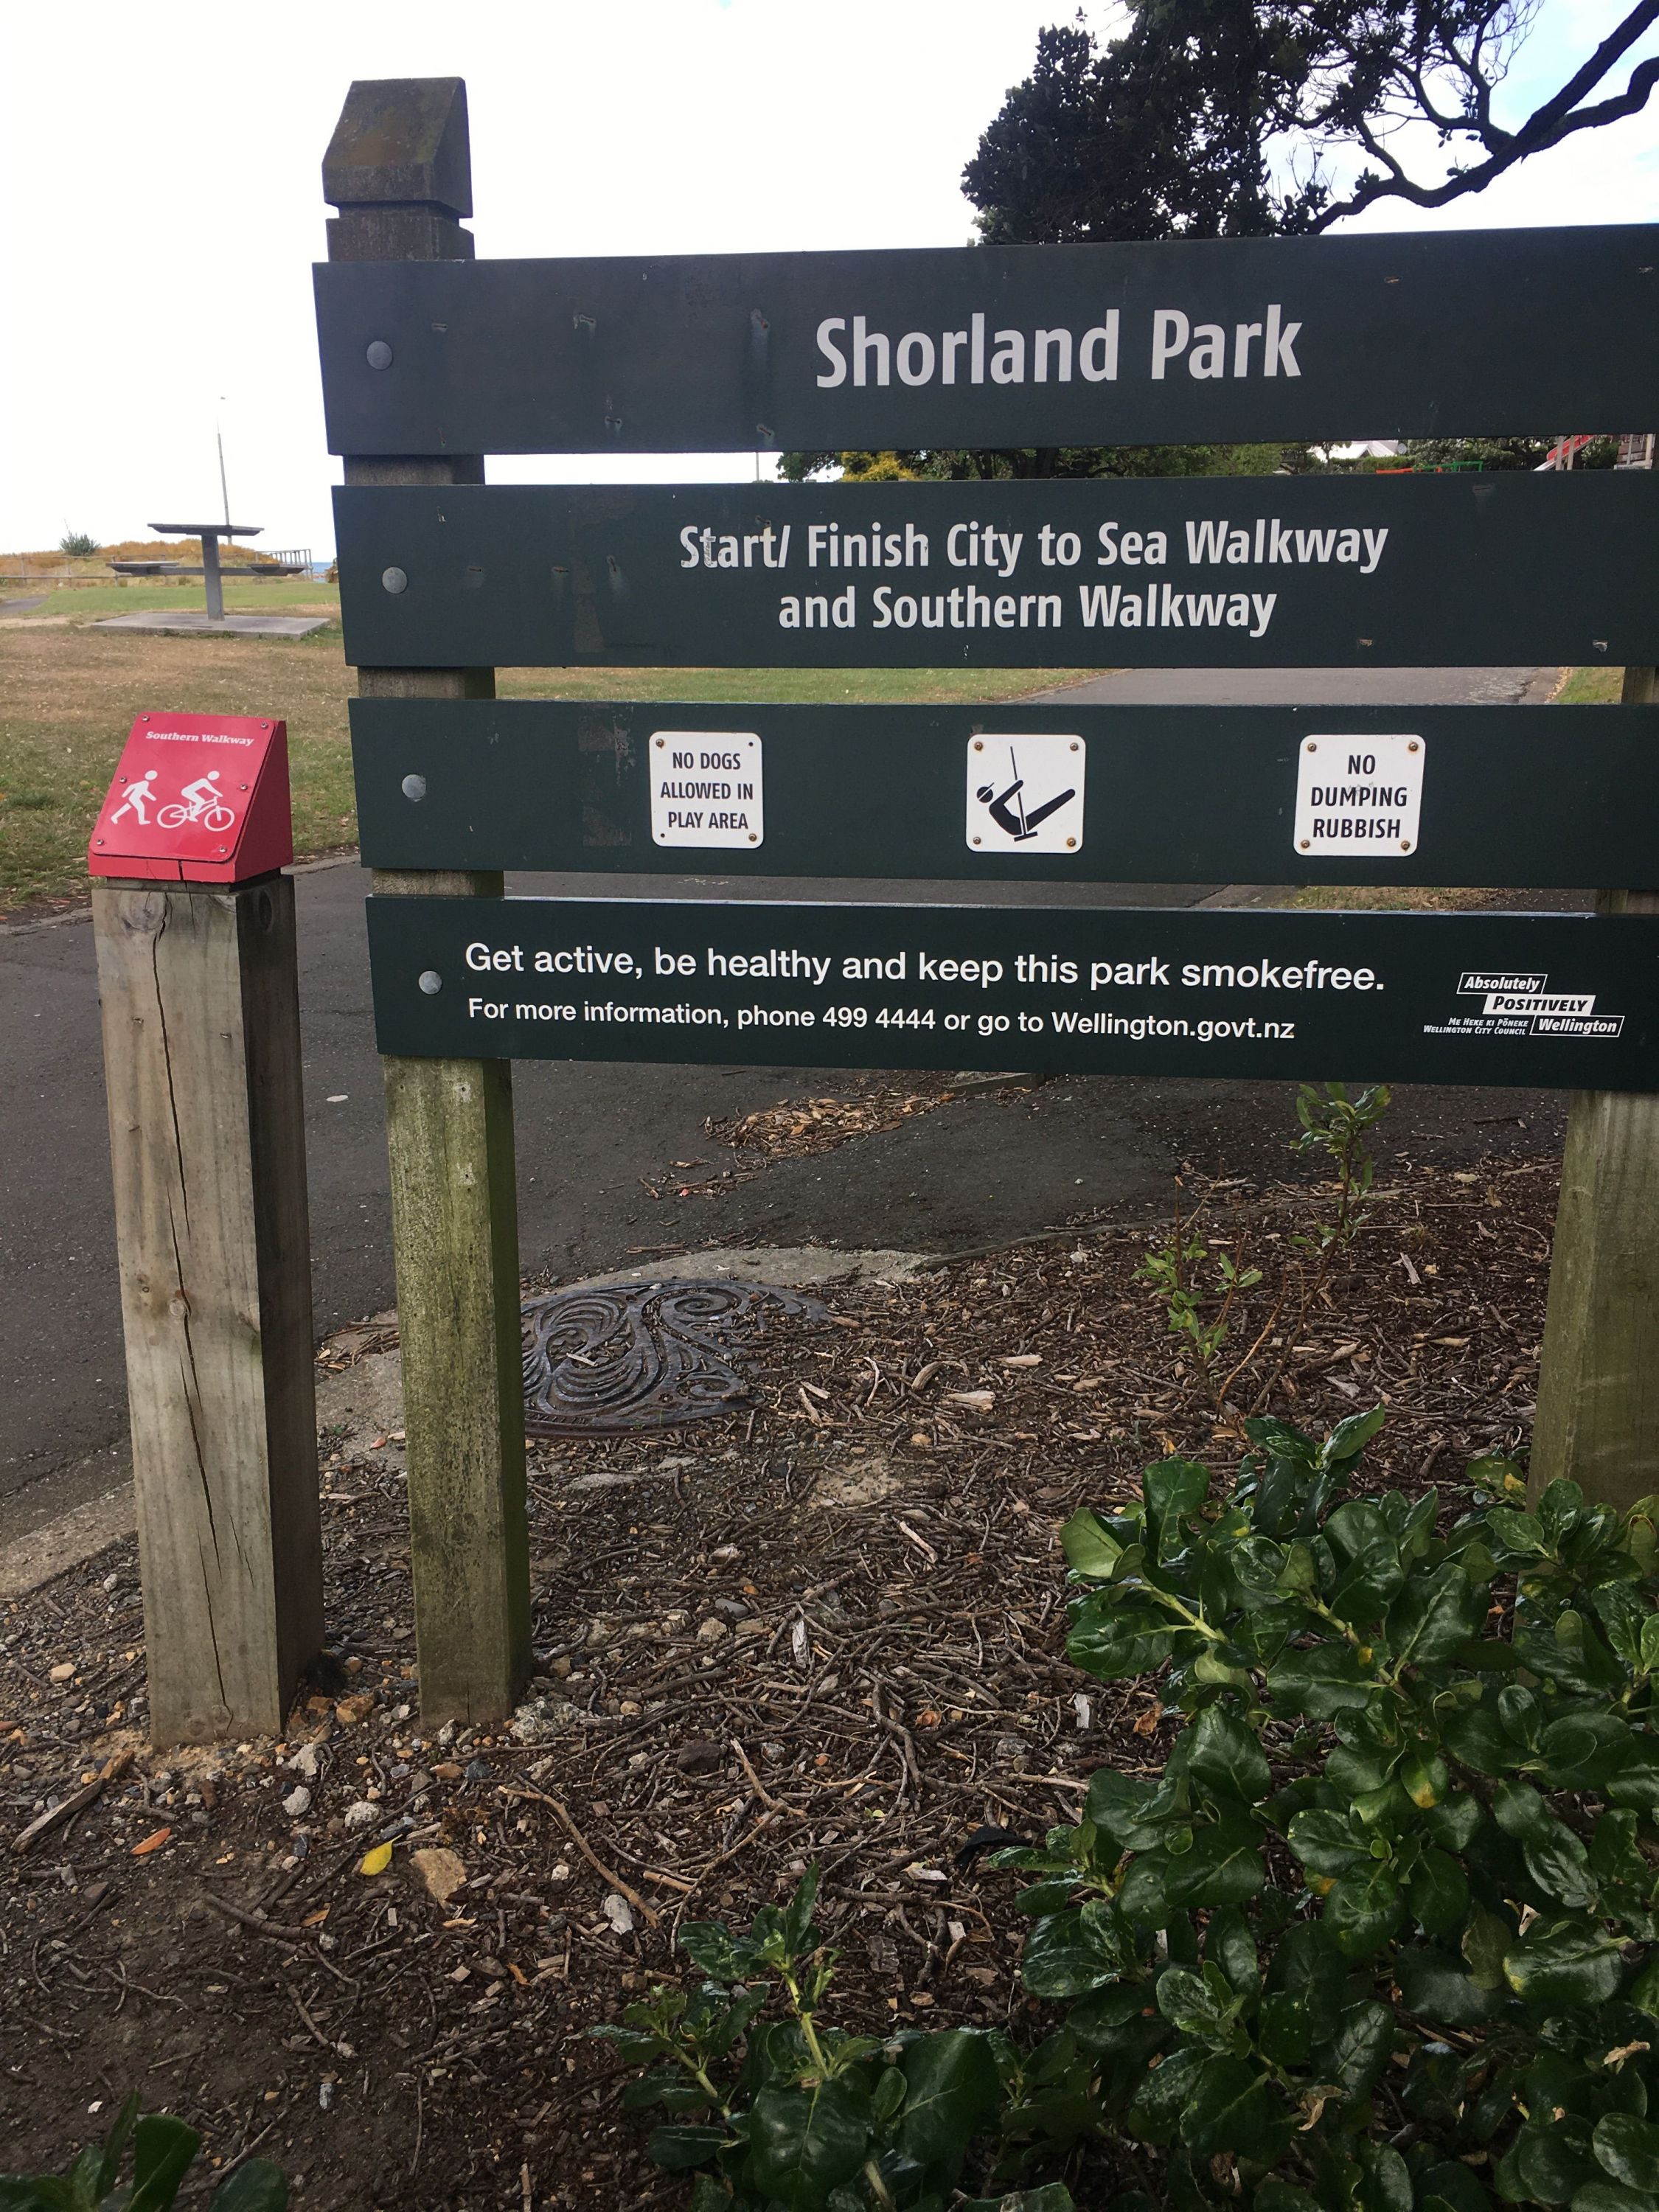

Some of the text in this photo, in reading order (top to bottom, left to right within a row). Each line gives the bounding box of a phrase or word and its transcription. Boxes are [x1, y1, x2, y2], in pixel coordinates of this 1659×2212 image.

[816, 304, 1303, 388] Shorland Park
[680, 518, 1389, 576] Start/ Finish City to Sea Walkway
[779, 583, 1278, 638] and Southern Walkway
[145, 731, 254, 747] Southern Walkway
[672, 752, 741, 770] NO DOGS
[1348, 754, 1376, 775] NO
[661, 782, 753, 800] ALLOWED IN
[1310, 787, 1408, 807] DUMPING
[668, 812, 748, 829] PLAY AREA
[1312, 818, 1401, 838] RUBBISH
[465, 942, 1384, 991] Get active, be healthy and keep this park smokefree.
[1464, 976, 1540, 992] Absolutely
[468, 998, 1295, 1042] For more information, phone 499 4444 or go to Wellington.govt.nz
[1538, 1018, 1617, 1034] Wellington
